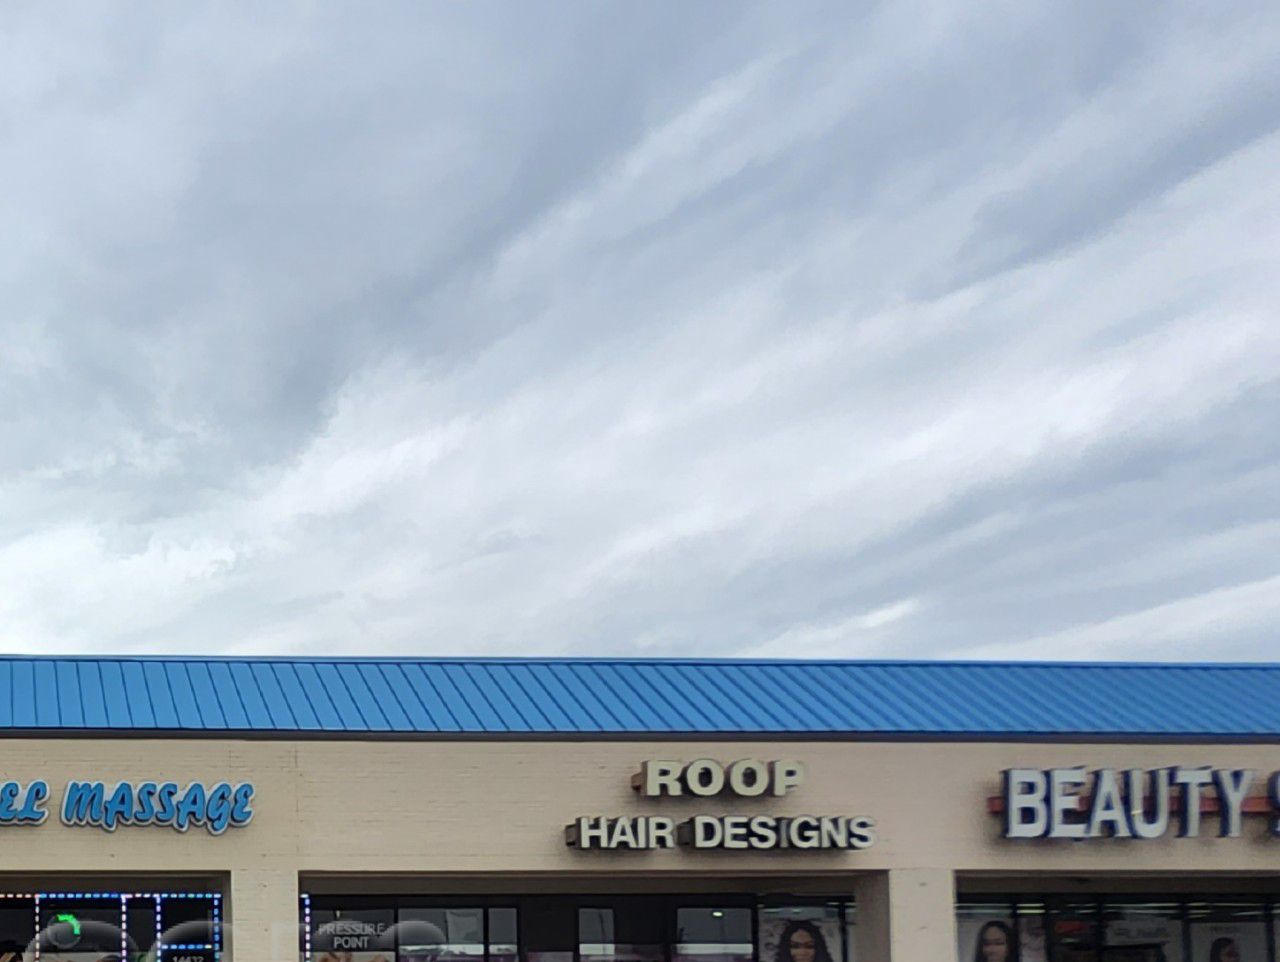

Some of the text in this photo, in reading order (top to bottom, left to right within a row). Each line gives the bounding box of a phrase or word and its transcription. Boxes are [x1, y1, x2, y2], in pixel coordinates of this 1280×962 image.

[641, 758, 806, 797] ROOP
[60, 779, 256, 835] MASSAGE
[1004, 766, 1254, 839] BEAUTY
[577, 815, 878, 849] HAIR DESIGNS
[318, 922, 386, 936] PRESSURE
[333, 936, 370, 949] POINT
